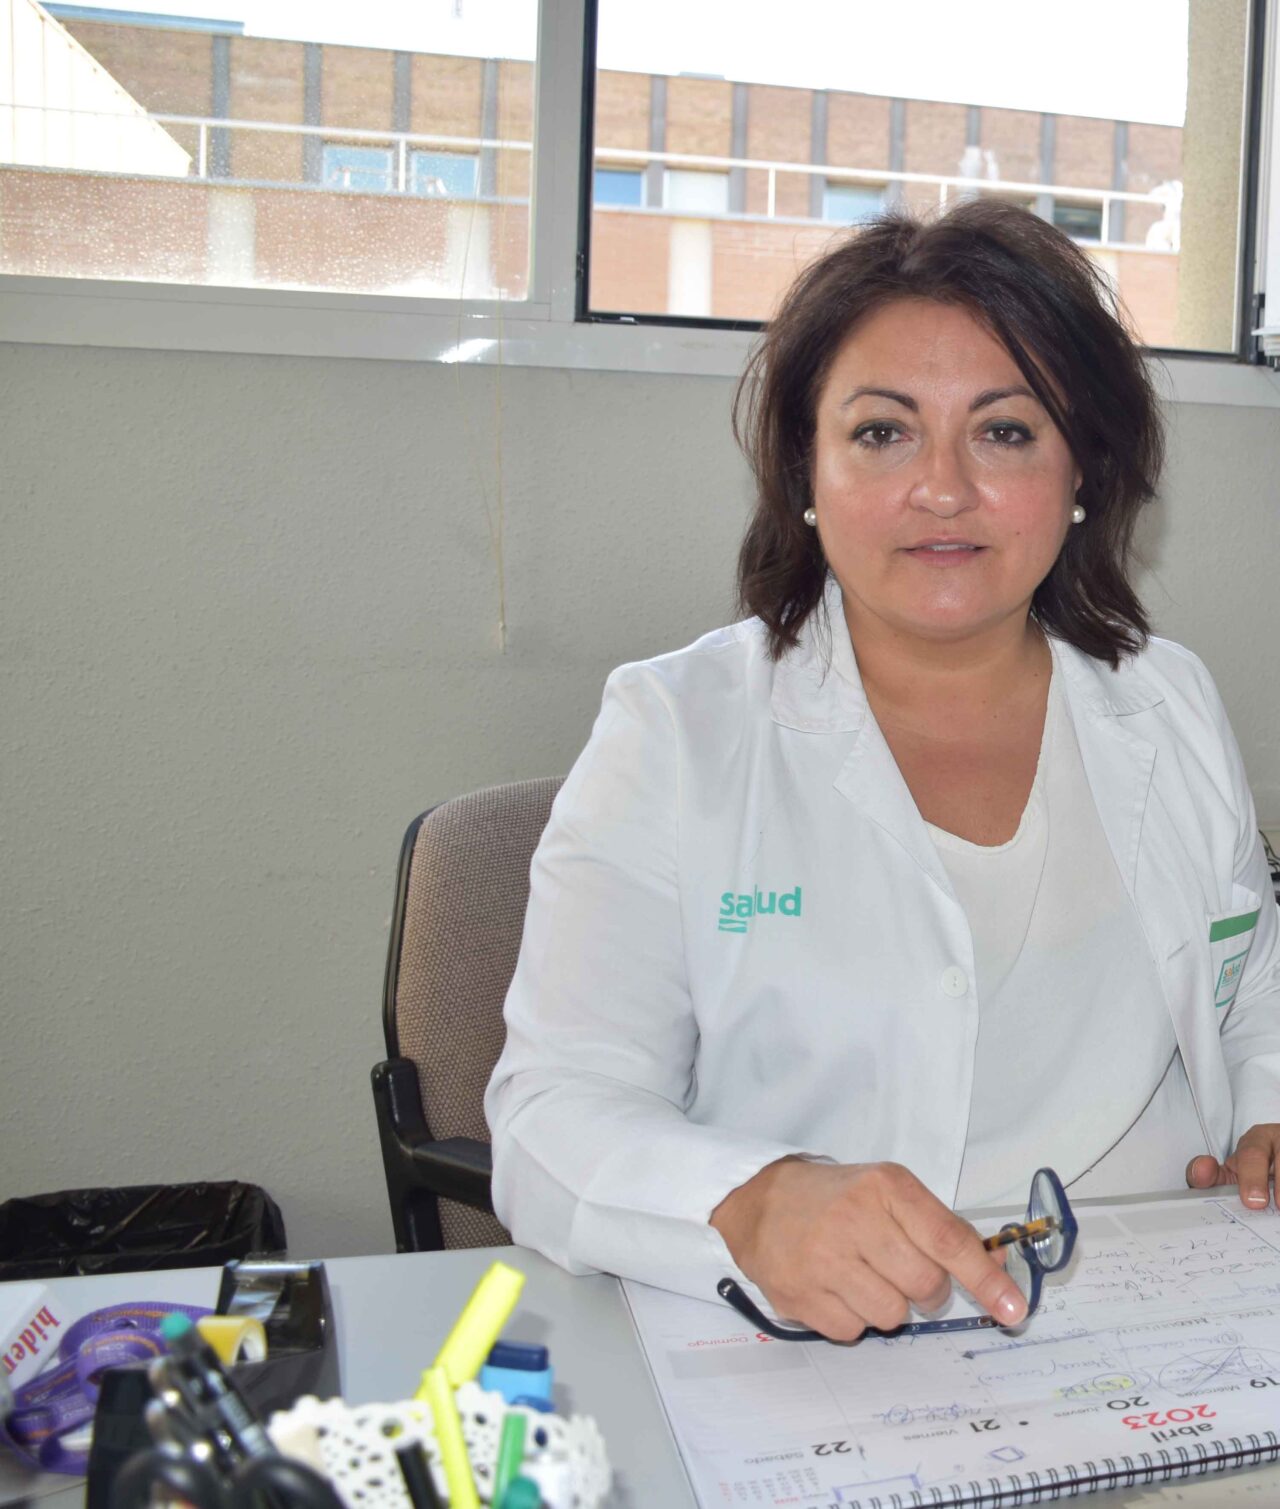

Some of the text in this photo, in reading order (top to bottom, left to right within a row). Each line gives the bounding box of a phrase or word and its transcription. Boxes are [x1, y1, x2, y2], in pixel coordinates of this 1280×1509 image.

[687, 1336, 749, 1348] Domingo
[1249, 1376, 1280, 1389] 19
[1106, 1396, 1150, 1411] 20
[1122, 1404, 1217, 1430] 2023
[969, 1419, 1001, 1433] 21
[1152, 1423, 1215, 1444] abril
[811, 1441, 852, 1456] 22
